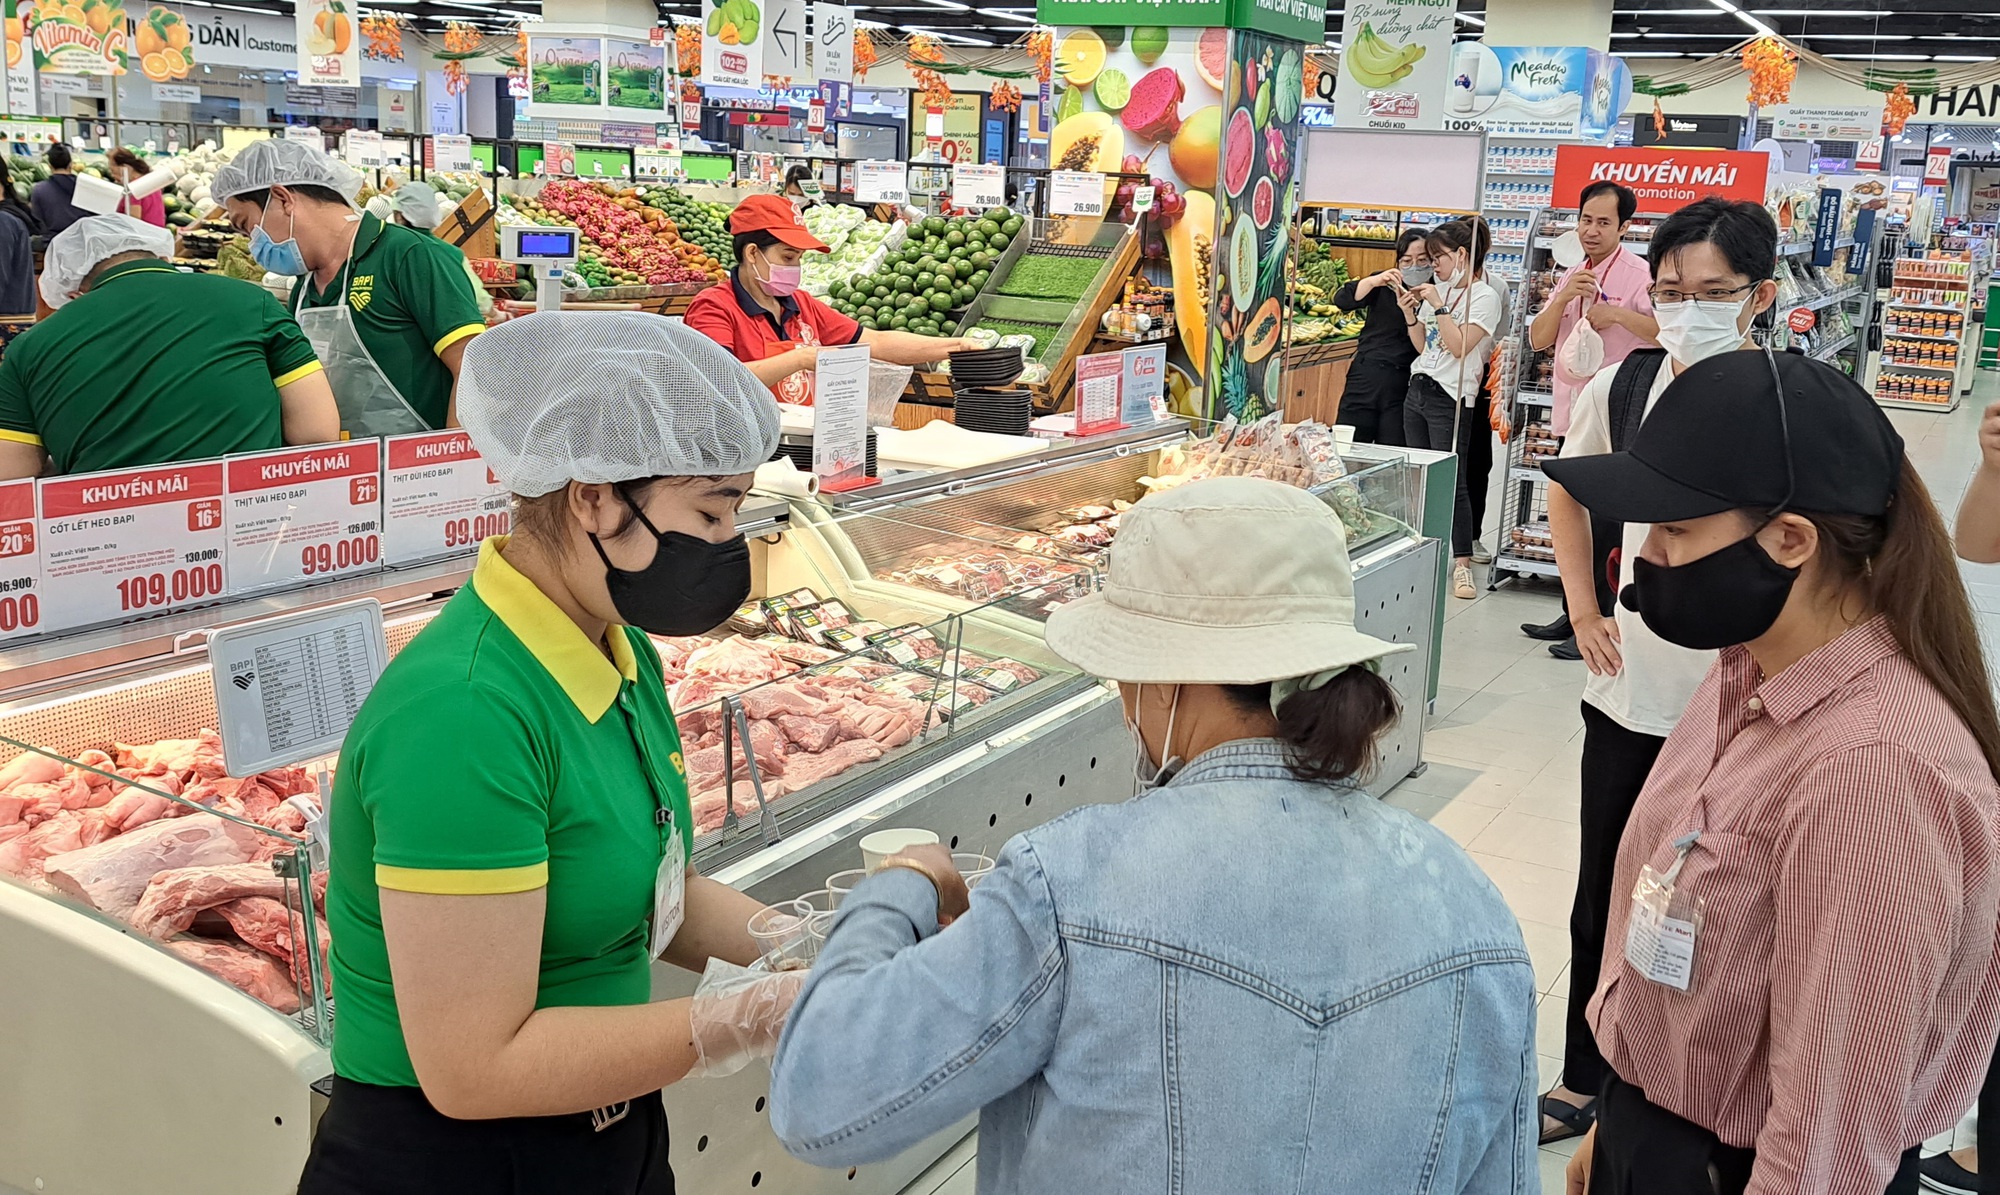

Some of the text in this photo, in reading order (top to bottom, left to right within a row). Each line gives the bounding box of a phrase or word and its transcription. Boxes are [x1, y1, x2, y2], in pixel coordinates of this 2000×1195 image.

[1307, 4, 1324, 23] NAM
[33, 19, 102, 58] Vitamin
[101, 29, 126, 63] C
[199, 16, 240, 48] DẪN
[1511, 59, 1567, 82] Meadow
[1530, 72, 1563, 88] Fresh
[685, 105, 698, 121] 32
[812, 108, 823, 124] 31
[1444, 120, 1484, 131] 100%
[1518, 126, 1536, 134] New
[1591, 158, 1738, 187] KHUYẾN MÃI
[1928, 157, 1946, 175] 24
[976, 195, 1001, 205] 26,900
[352, 275, 373, 286] BAPI
[416, 437, 465, 459] KHUYẾN
[261, 452, 350, 480] KHUYẾN MÃI
[423, 470, 436, 479] HEO
[438, 468, 453, 476] BAPI
[82, 473, 189, 505] KHUYẾN MÃI
[234, 489, 307, 508] THỊT VAI HEO BAPI
[356, 484, 376, 502] 21%
[50, 514, 135, 535] CỐT LẾT HEO BAPI
[195, 508, 220, 528] 16%
[445, 511, 509, 547] 99,000
[185, 549, 218, 564] 130,000
[302, 534, 378, 575] 99,000
[116, 563, 223, 612] 109,000
[230, 659, 254, 672] BAPI
[661, 901, 681, 936] VISITOR
